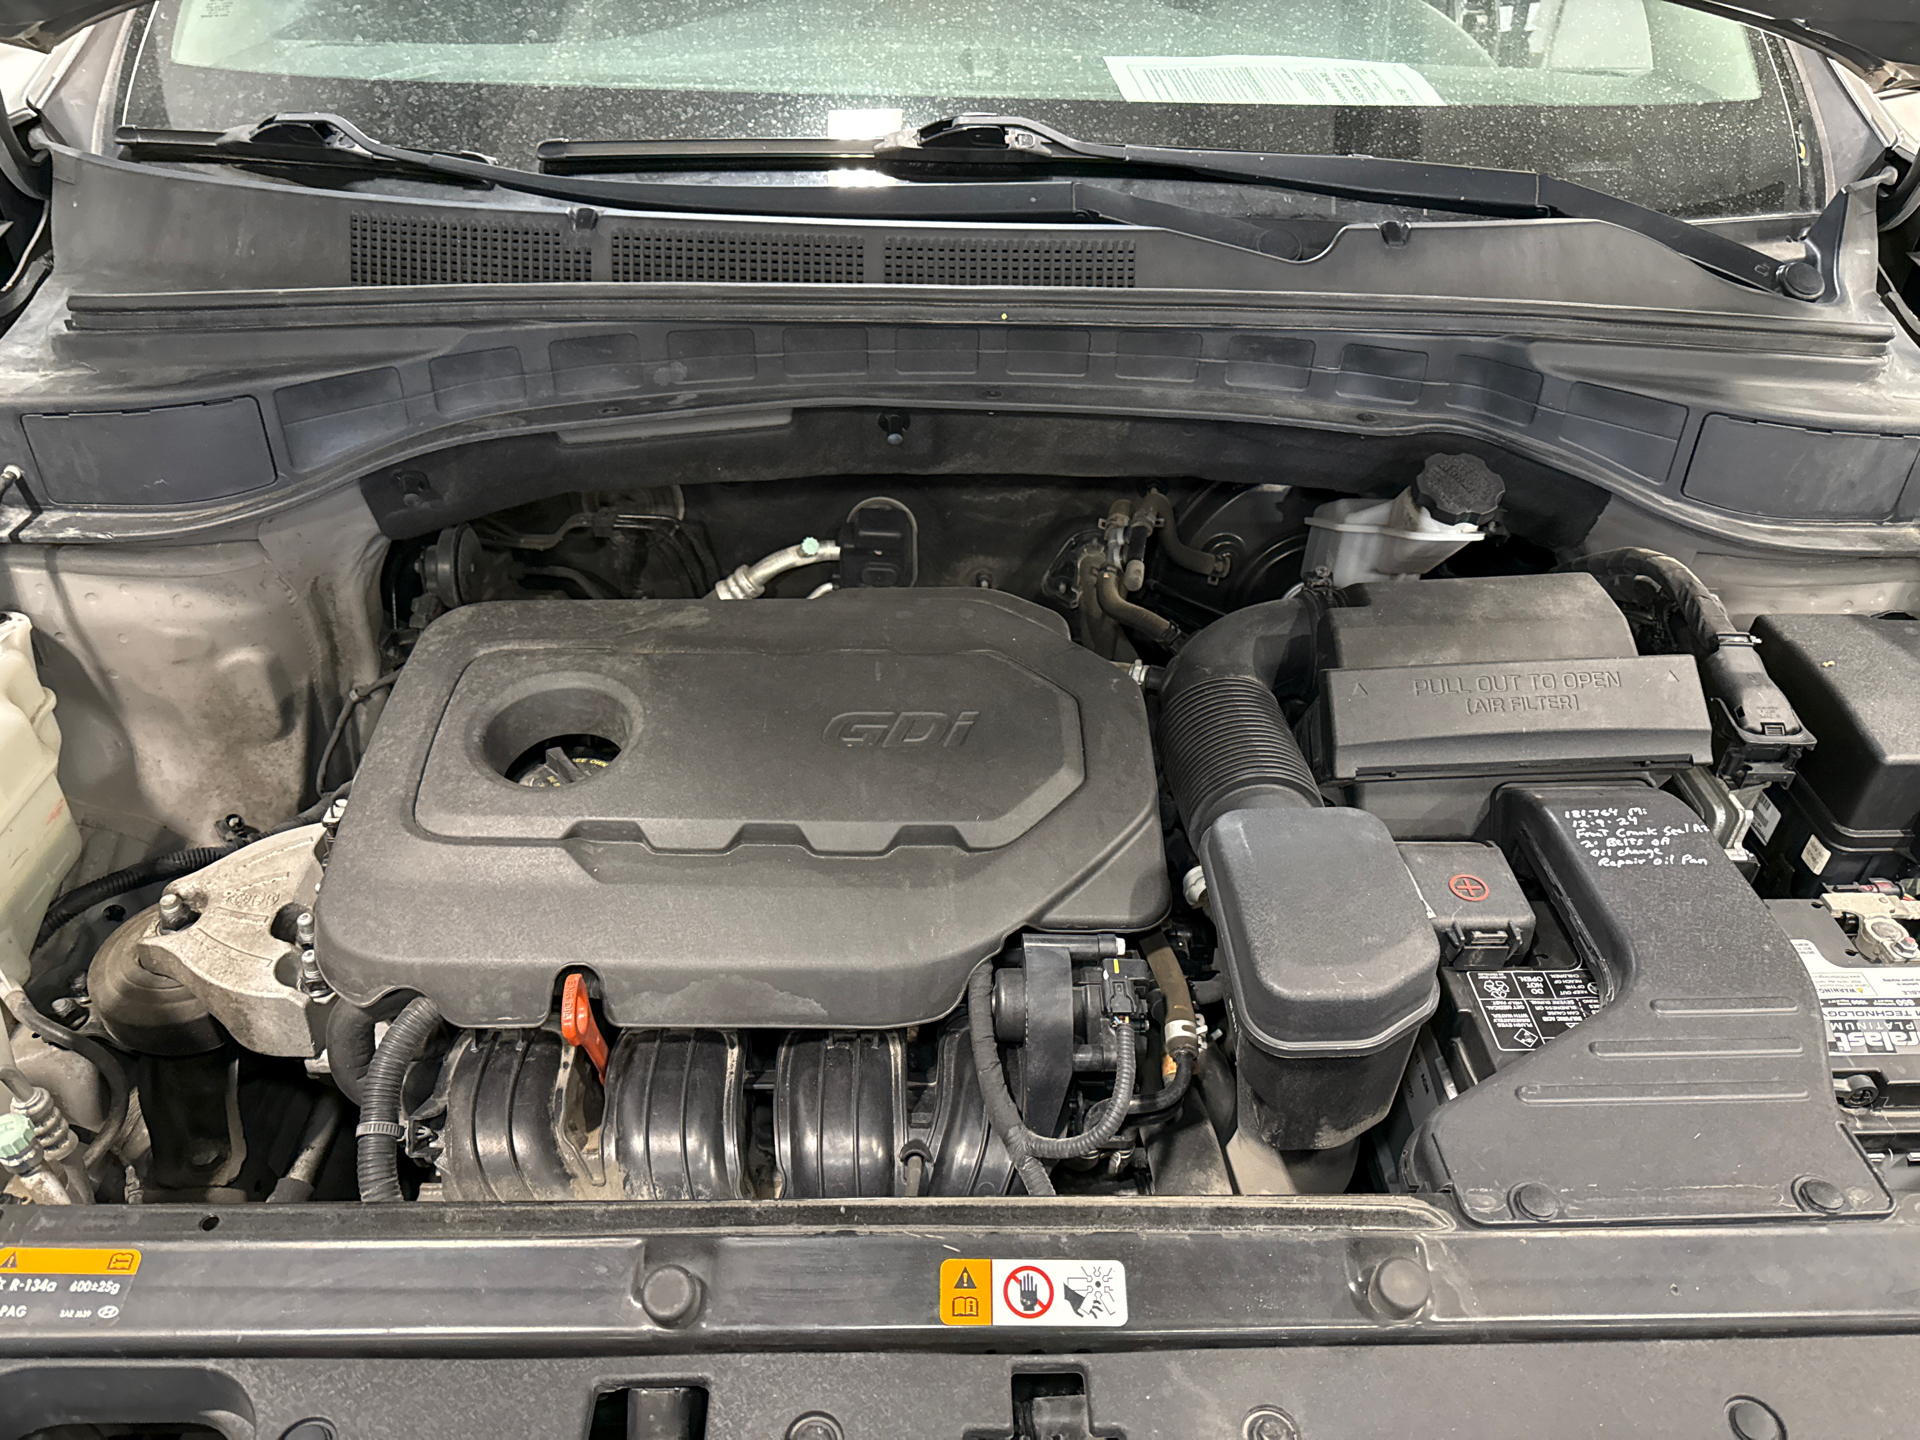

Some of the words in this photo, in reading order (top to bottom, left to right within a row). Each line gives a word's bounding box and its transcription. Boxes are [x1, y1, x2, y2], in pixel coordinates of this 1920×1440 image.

[1412, 678, 1472, 696] PULL
[1475, 674, 1521, 693] OUT
[1527, 673, 1557, 691] TO
[1562, 671, 1622, 689] OPEN
[822, 711, 979, 748] GDi
[1598, 858, 1646, 868] Repair
[1681, 854, 1708, 866] Pan
[1829, 1021, 1915, 1031] PLATINUM
[1833, 1031, 1920, 1052] ralast
[0, 1305, 27, 1317] PAG
